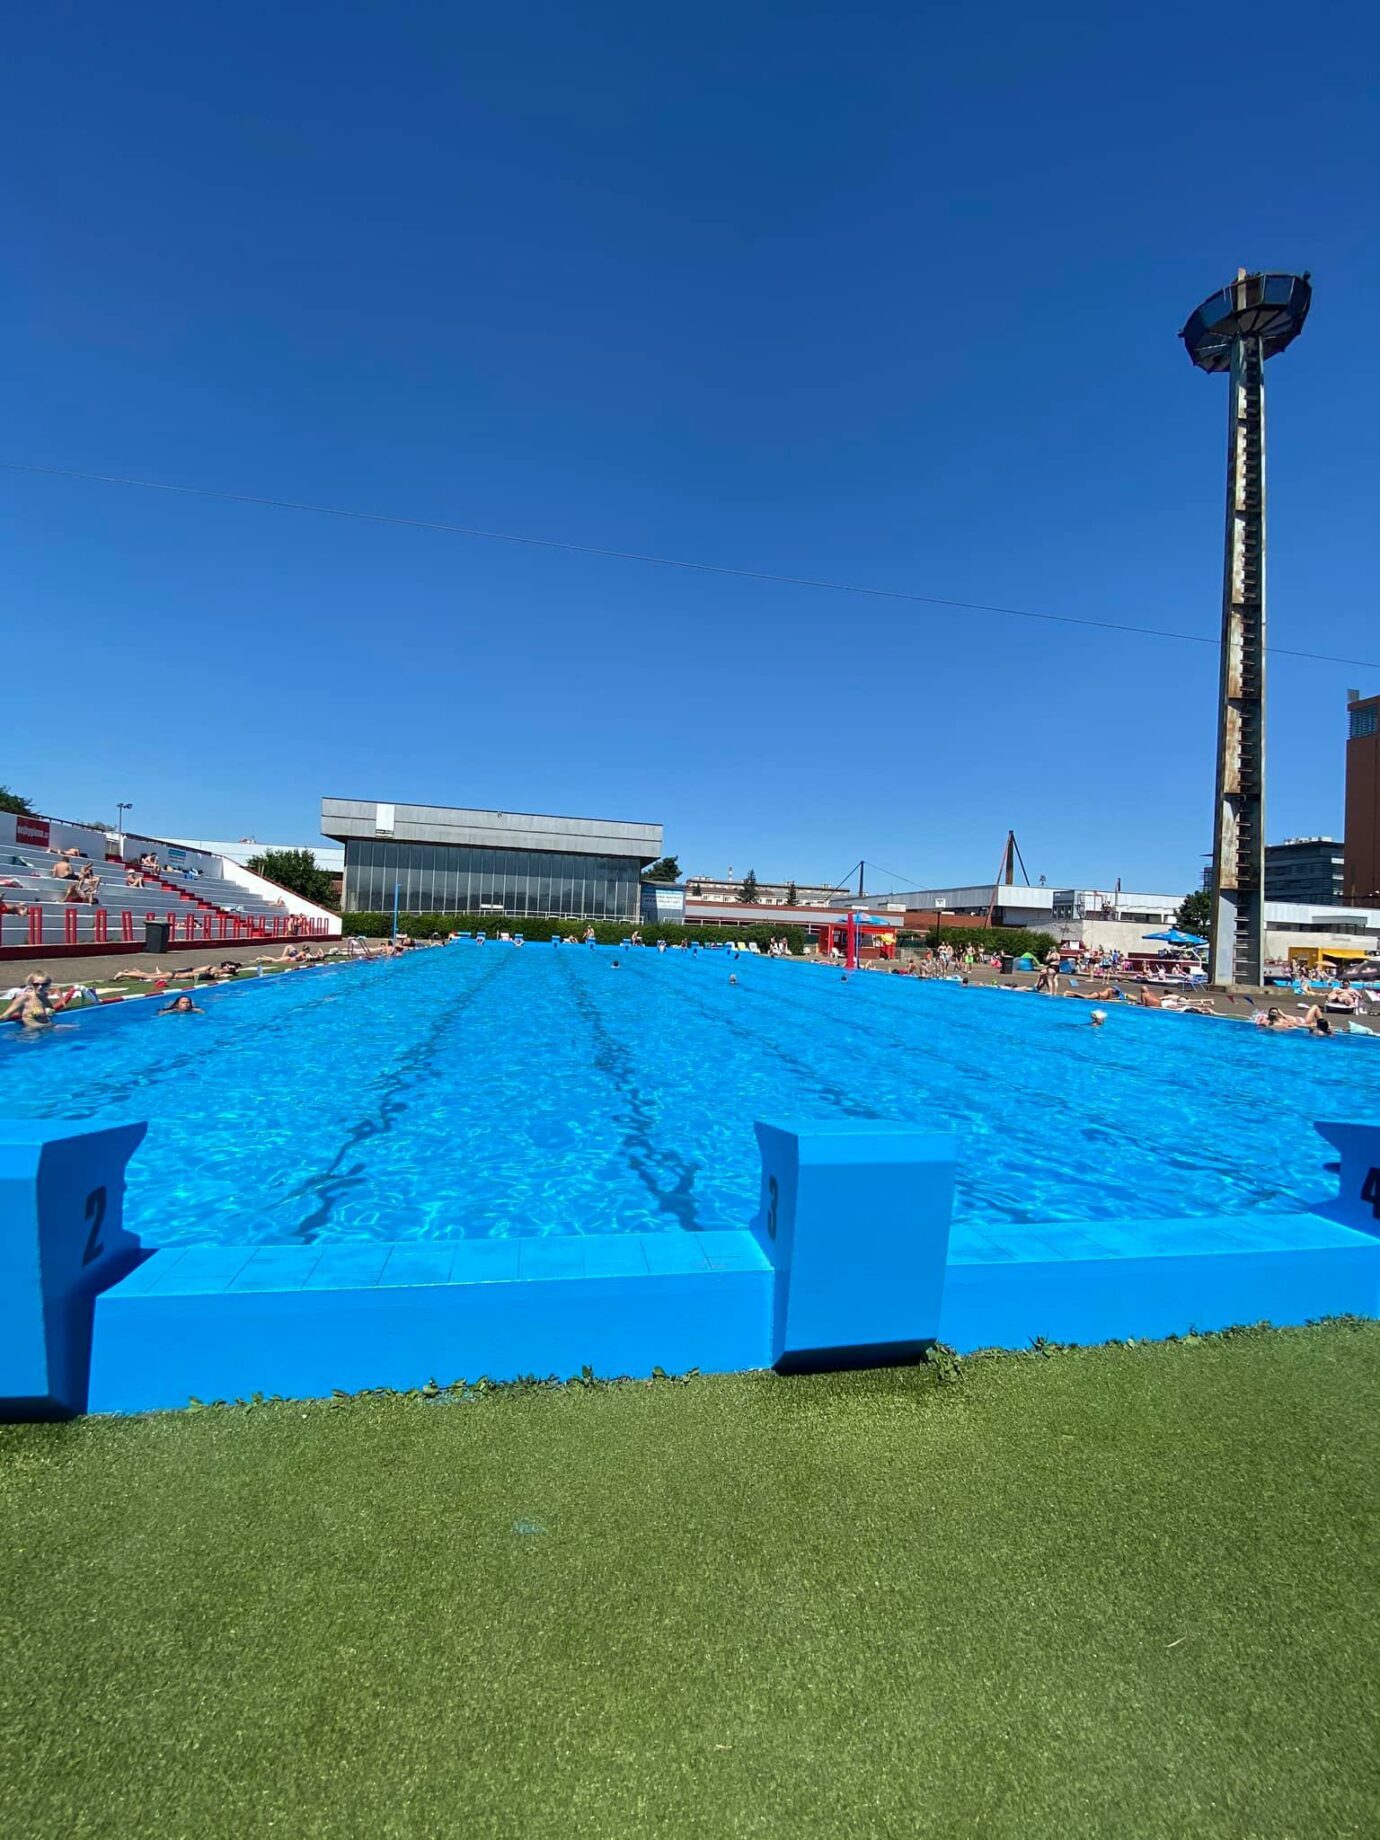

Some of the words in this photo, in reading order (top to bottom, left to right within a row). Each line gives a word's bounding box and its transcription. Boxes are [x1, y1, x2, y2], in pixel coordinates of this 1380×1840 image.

[82, 1184, 106, 1267] 2
[767, 1175, 779, 1242] 3
[1360, 1166, 1380, 1220] 4
